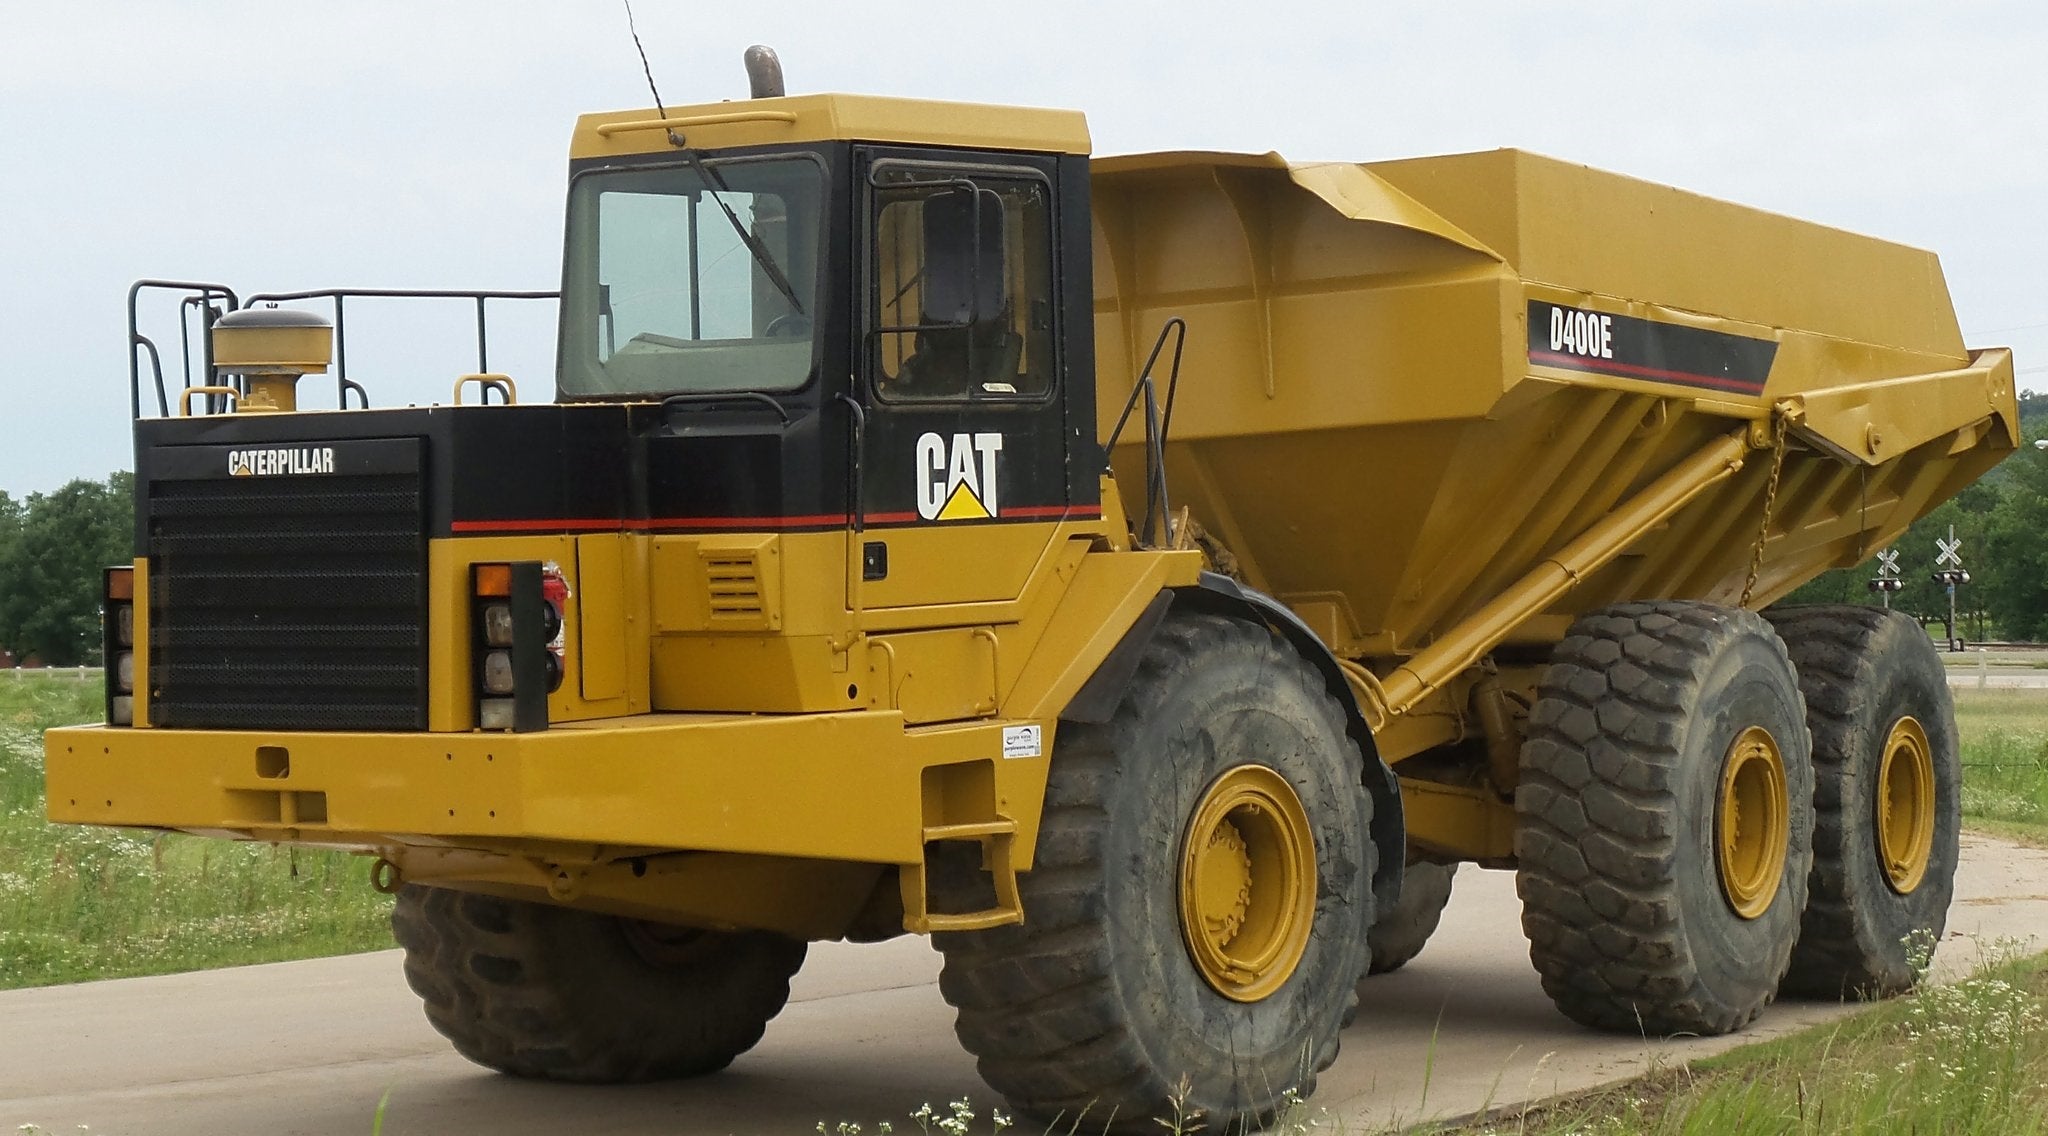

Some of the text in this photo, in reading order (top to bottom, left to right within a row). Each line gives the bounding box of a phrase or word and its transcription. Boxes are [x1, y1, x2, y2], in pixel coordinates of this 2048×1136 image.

[1551, 306, 1613, 359] D400E
[228, 447, 334, 476] CATERPILLAR
[916, 432, 1003, 521] CAT
